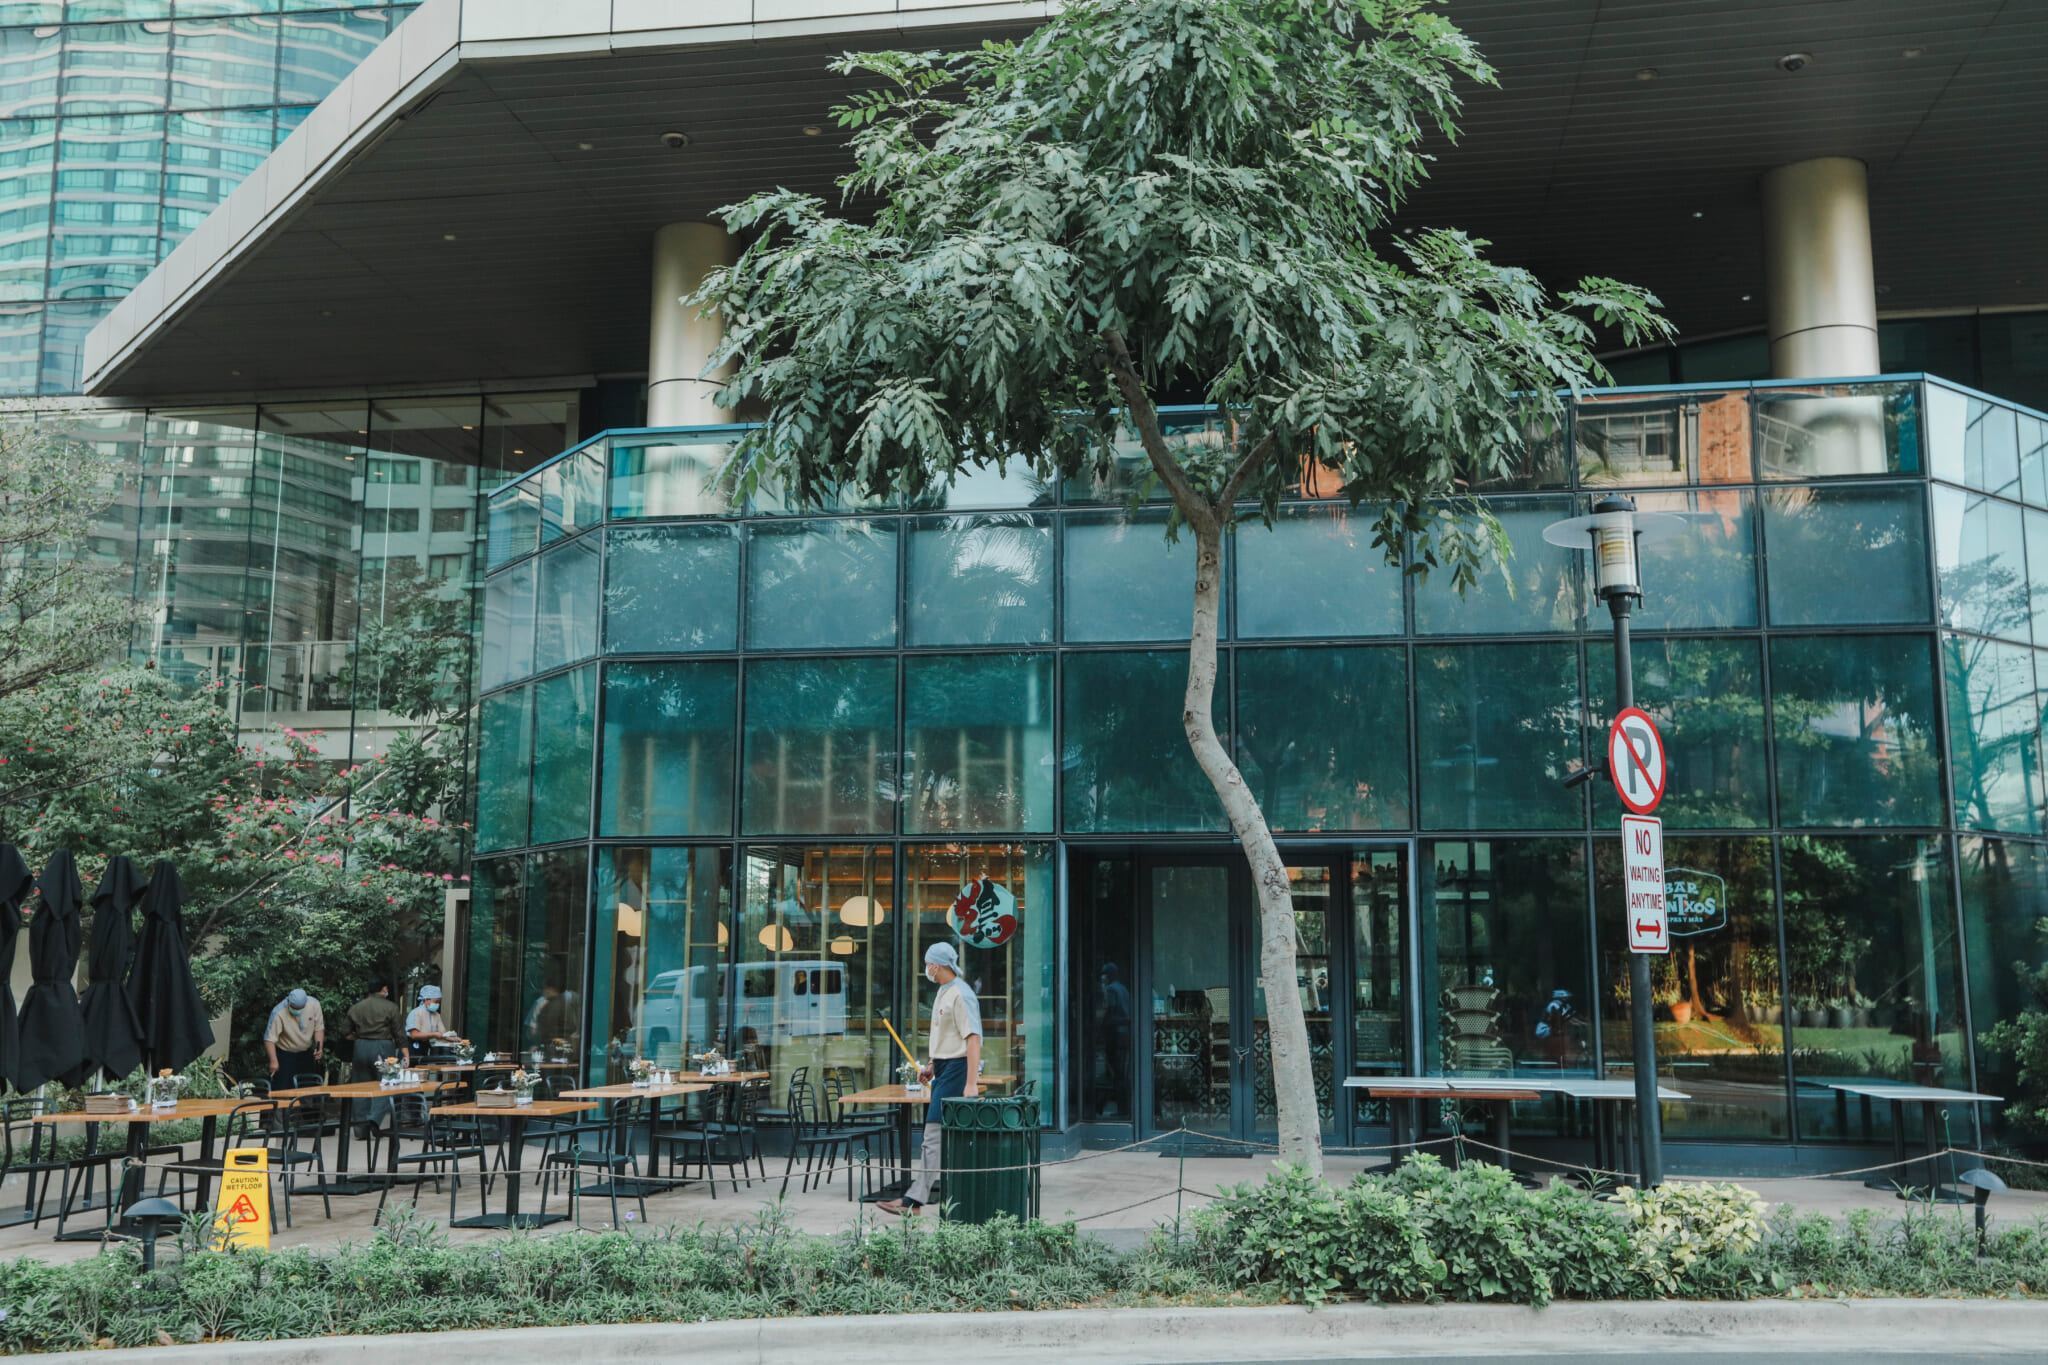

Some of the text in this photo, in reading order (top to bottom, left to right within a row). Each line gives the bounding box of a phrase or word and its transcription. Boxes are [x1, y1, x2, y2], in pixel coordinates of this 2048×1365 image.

[1635, 829, 1652, 856] NO
[1630, 865, 1660, 883] WAITING
[1665, 881, 1699, 895] BAR
[1631, 892, 1663, 910] ANYTIME
[1666, 894, 1716, 915] NTXOS
